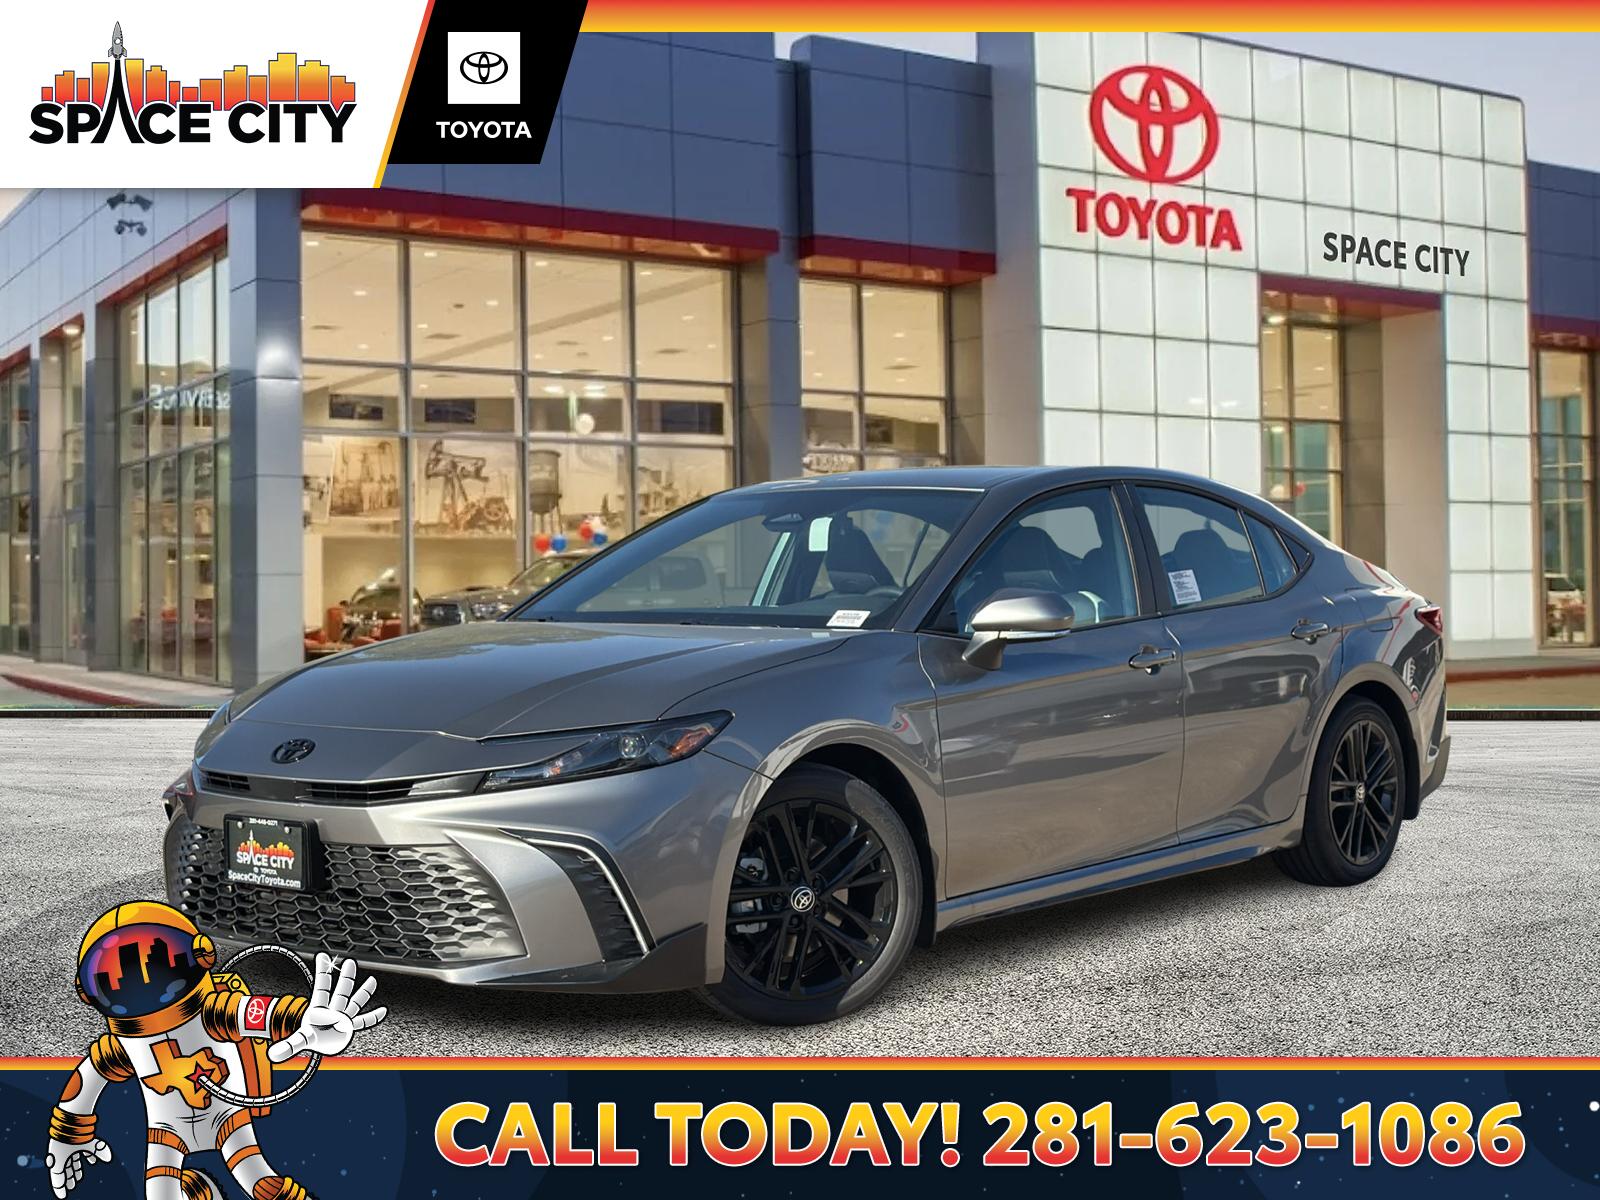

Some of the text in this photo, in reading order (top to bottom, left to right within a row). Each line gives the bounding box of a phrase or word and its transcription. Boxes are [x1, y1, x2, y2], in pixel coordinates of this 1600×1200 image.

[1066, 187, 1242, 251] TOYOTA
[1322, 231, 1470, 277] SPACE CITY
[236, 848, 294, 870] SPACE CITY
[228, 869, 301, 888] SpaceCityToyota.com
